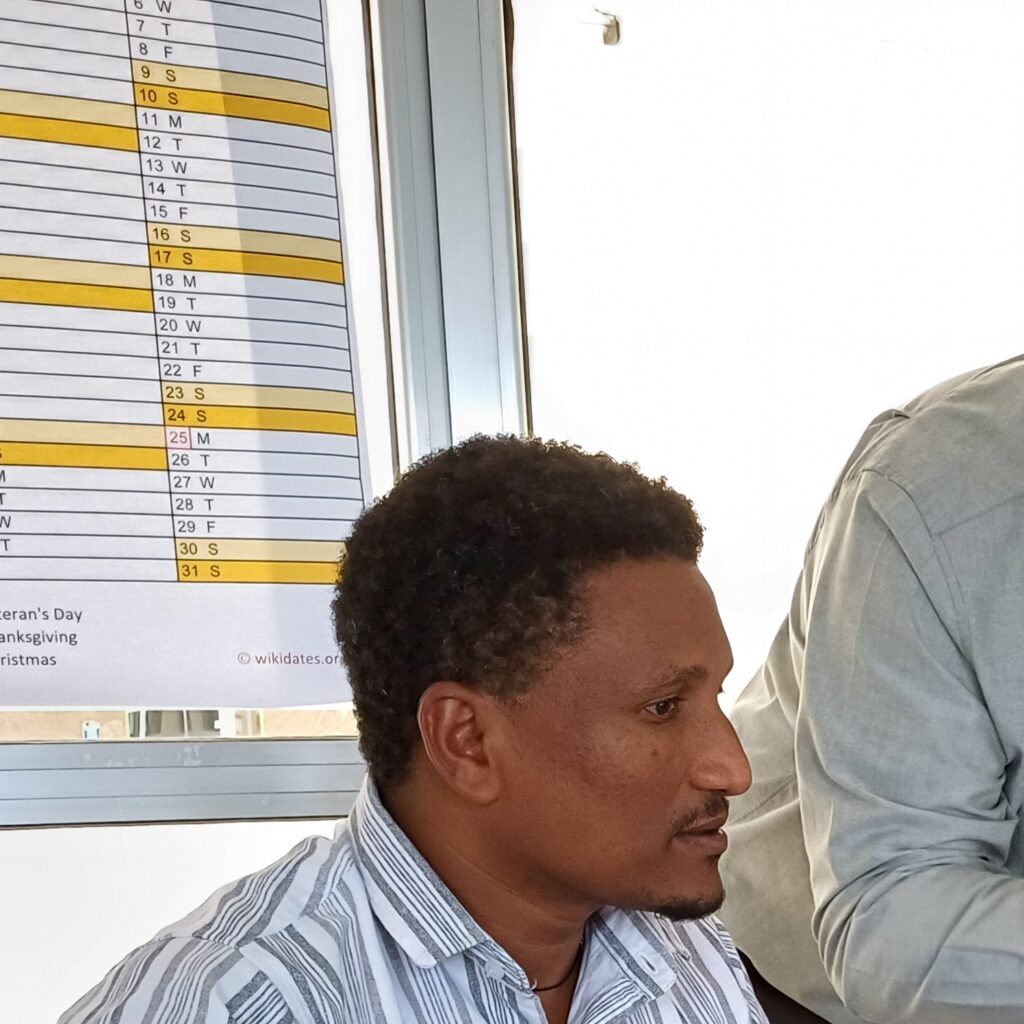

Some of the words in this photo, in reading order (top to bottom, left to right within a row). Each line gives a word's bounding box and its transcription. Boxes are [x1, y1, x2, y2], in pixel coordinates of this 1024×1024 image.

[134, 0, 143, 9] 6
[155, 0, 172, 13] W
[136, 19, 144, 31] 7
[161, 22, 171, 36] T
[139, 42, 148, 55] 8
[164, 46, 172, 58] F
[141, 66, 150, 78] 9
[166, 69, 177, 82] S
[139, 89, 157, 102] 10
[168, 92, 179, 105] S
[142, 113, 158, 126] 11
[169, 116, 182, 128] M
[143, 137, 161, 149] 12
[172, 138, 182, 150] T
[146, 160, 163, 172] 13
[172, 161, 188, 173] W
[148, 182, 165, 195] 14
[176, 184, 186, 197] T
[150, 206, 168, 218] 15
[179, 208, 188, 219] F
[152, 228, 170, 241] 16
[180, 230, 191, 242] S
[154, 251, 171, 263] 17
[182, 252, 193, 265] S
[157, 274, 174, 286] 18
[183, 275, 196, 288] M
[158, 297, 176, 309] 19
[186, 298, 197, 310] T
[160, 320, 178, 331] 20
[186, 320, 202, 332] W
[161, 342, 178, 354] 21
[190, 343, 200, 354] T
[163, 365, 182, 376] 22
[193, 366, 202, 377] F
[166, 387, 184, 399] 23
[194, 388, 205, 400] S
[168, 410, 185, 421] 24
[197, 410, 207, 422] S
[170, 432, 188, 444] 25
[197, 433, 210, 444] M
[172, 454, 189, 466] 26
[200, 455, 210, 466] T
[174, 477, 191, 488] 27
[199, 477, 215, 488] W
[176, 499, 194, 511] 28
[204, 500, 214, 511] T
[178, 522, 196, 533] 29
[207, 522, 215, 533] F
[0, 538, 10, 551] T
[180, 544, 198, 555] 30
[208, 544, 218, 555] S
[182, 566, 198, 577] 31
[210, 566, 220, 578] S
[54, 608, 82, 623] Day
[255, 652, 339, 665] wikidates.or
